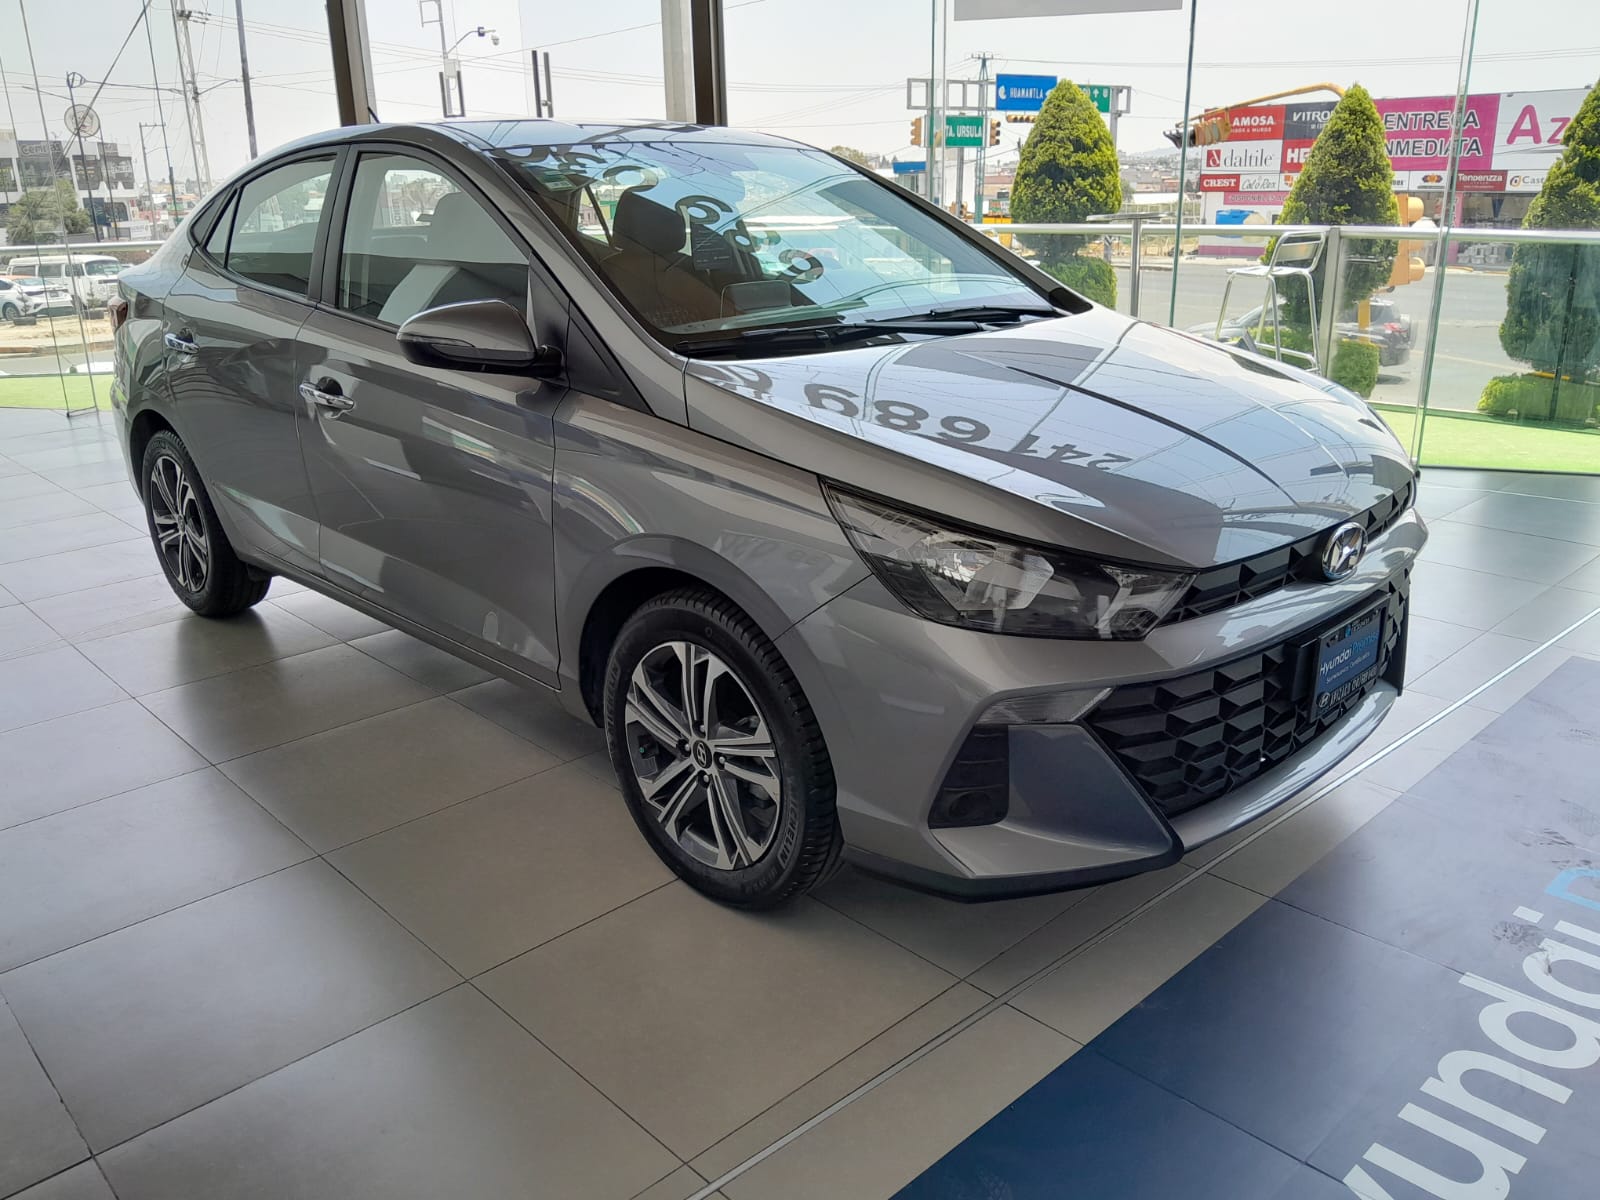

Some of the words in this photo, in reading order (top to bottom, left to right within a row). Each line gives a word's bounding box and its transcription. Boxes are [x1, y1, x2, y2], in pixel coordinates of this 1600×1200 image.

[1010, 88, 1043, 99] HUAMANTLA
[1293, 110, 1334, 123] VITRO
[1383, 110, 1480, 131] ENTREA
[957, 125, 982, 138] URSULA
[1223, 148, 1272, 167] daltile
[1203, 178, 1236, 187] CREST
